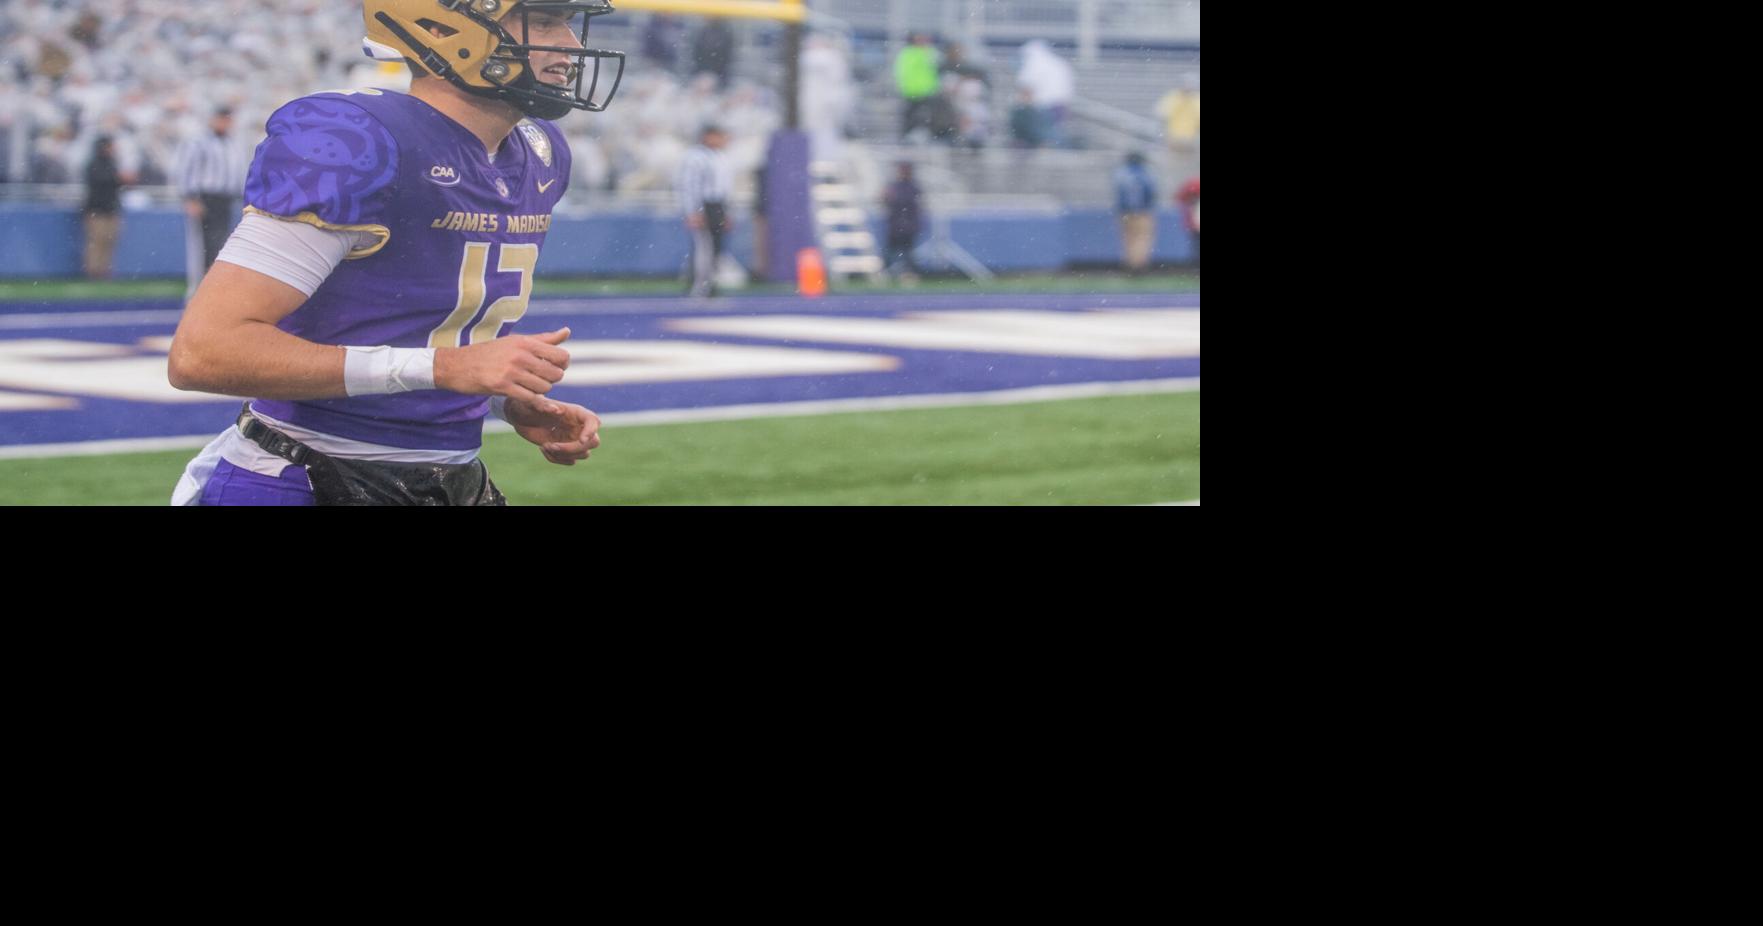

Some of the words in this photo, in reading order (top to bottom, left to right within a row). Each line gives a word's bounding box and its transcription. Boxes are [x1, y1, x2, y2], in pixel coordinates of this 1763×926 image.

[430, 166, 455, 178] CAA
[431, 211, 498, 233] JAMES
[506, 214, 552, 233] MADISO
[428, 241, 538, 348] 12
